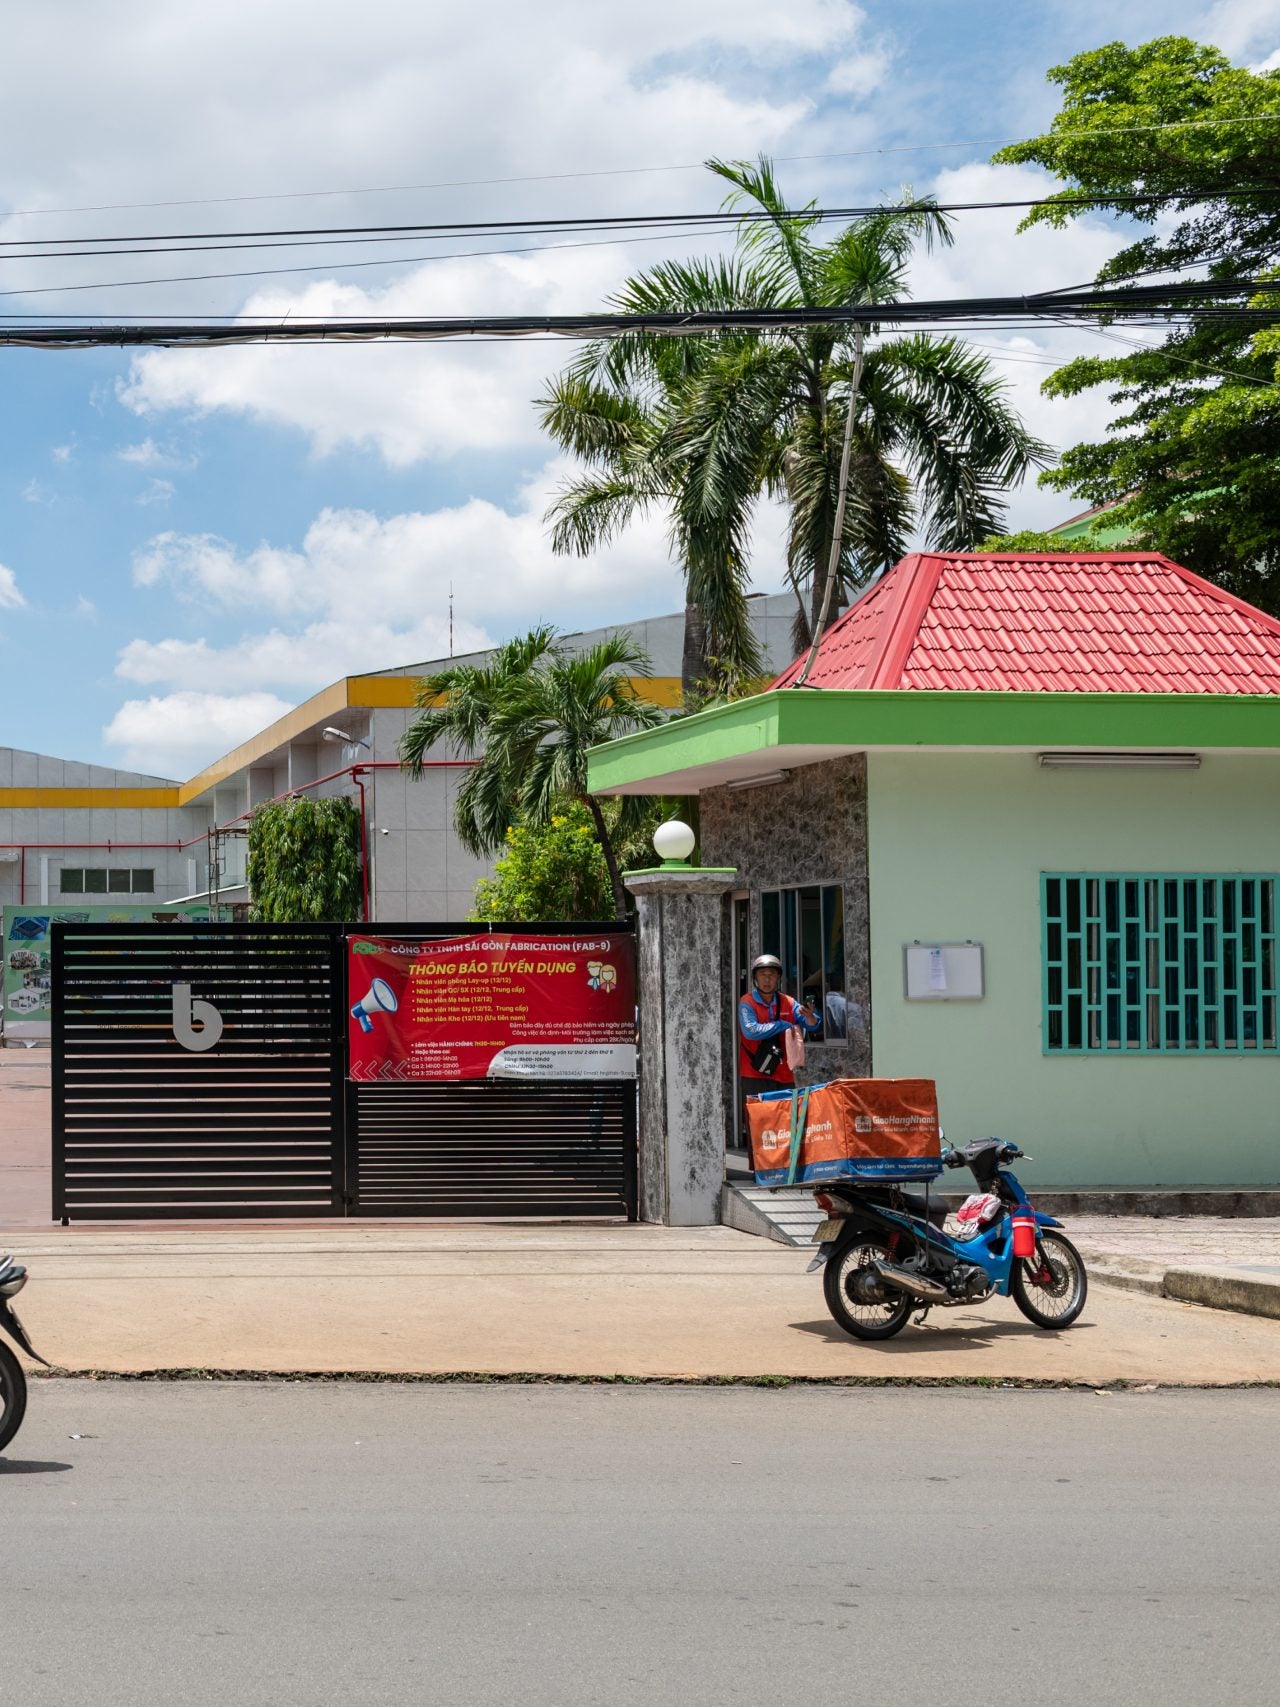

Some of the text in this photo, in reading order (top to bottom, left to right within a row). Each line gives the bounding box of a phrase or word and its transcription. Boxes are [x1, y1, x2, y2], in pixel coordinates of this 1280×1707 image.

[391, 944, 420, 954] CÔNG
[436, 945, 463, 953] TNHH
[481, 940, 503, 950] GÒN
[505, 942, 570, 951] FABRICATION
[572, 940, 610, 953] (FAB-9)
[408, 958, 576, 976] THÔNG BÁO TUYỂN DỤNG
[872, 1115, 936, 1126] GiaoHangNhanh
